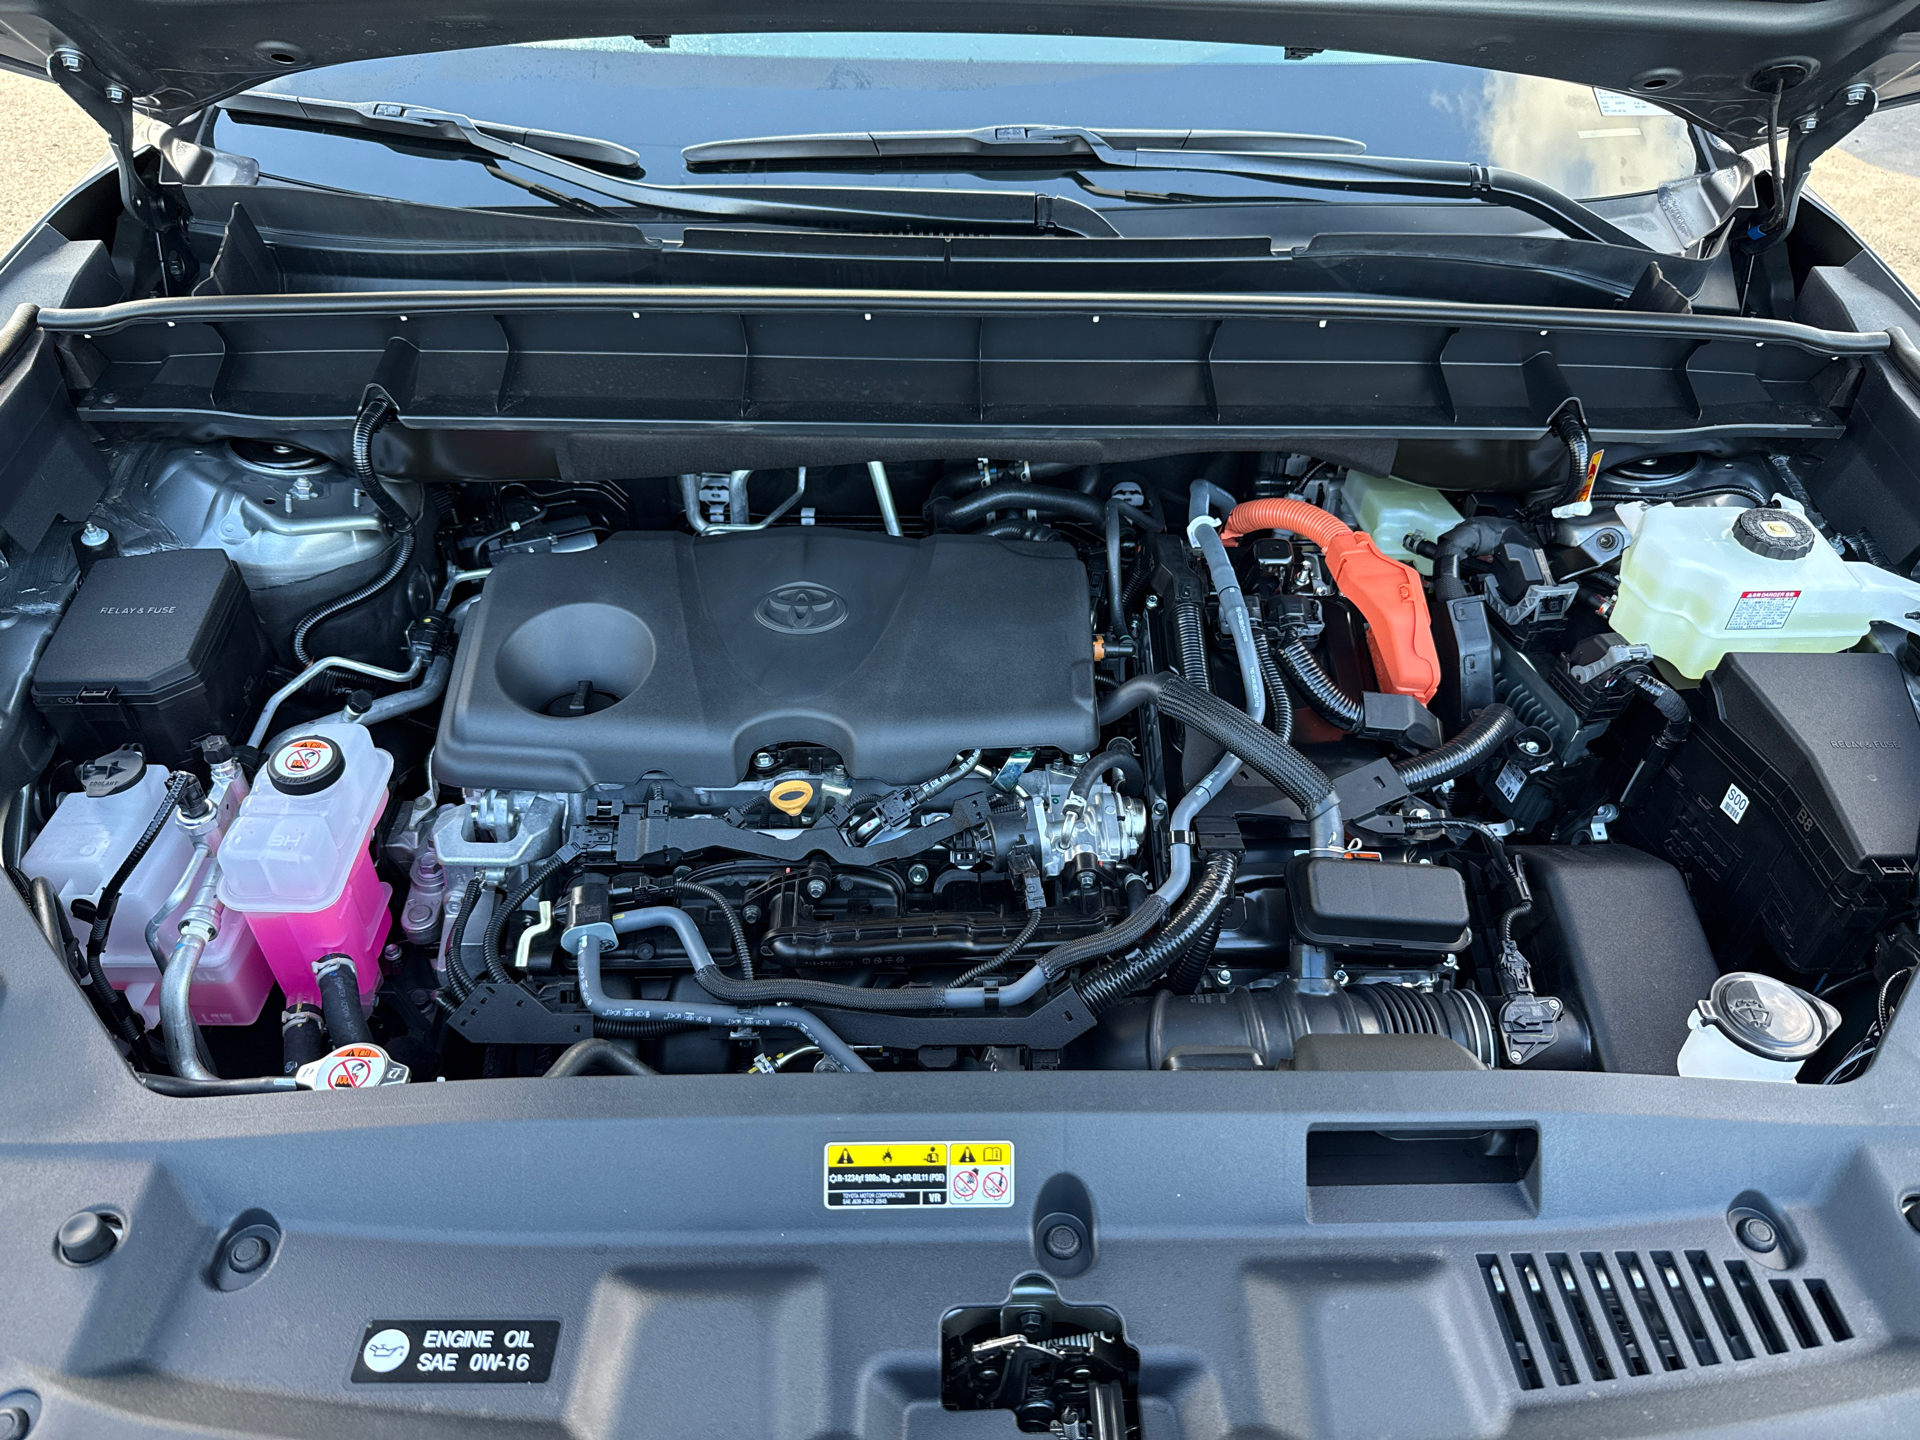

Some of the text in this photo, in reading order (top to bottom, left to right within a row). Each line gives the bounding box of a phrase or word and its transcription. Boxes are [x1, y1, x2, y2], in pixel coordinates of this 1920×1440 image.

[99, 607, 137, 615] RELAY
[146, 606, 177, 615] FUSE
[1829, 740, 1863, 749] RELAY
[1873, 740, 1901, 749] FUSE
[1504, 786, 1515, 800] N1
[1796, 807, 1813, 832] B8
[201, 1013, 234, 1023] LOW
[837, 1173, 865, 1184] R-1234yf
[902, 1173, 928, 1182] ND-OIL11
[929, 1173, 946, 1183] (POE)
[928, 1193, 942, 1203] VR
[422, 1329, 535, 1348] ENGINE OIL
[416, 1353, 531, 1372] SAE 0W-16
